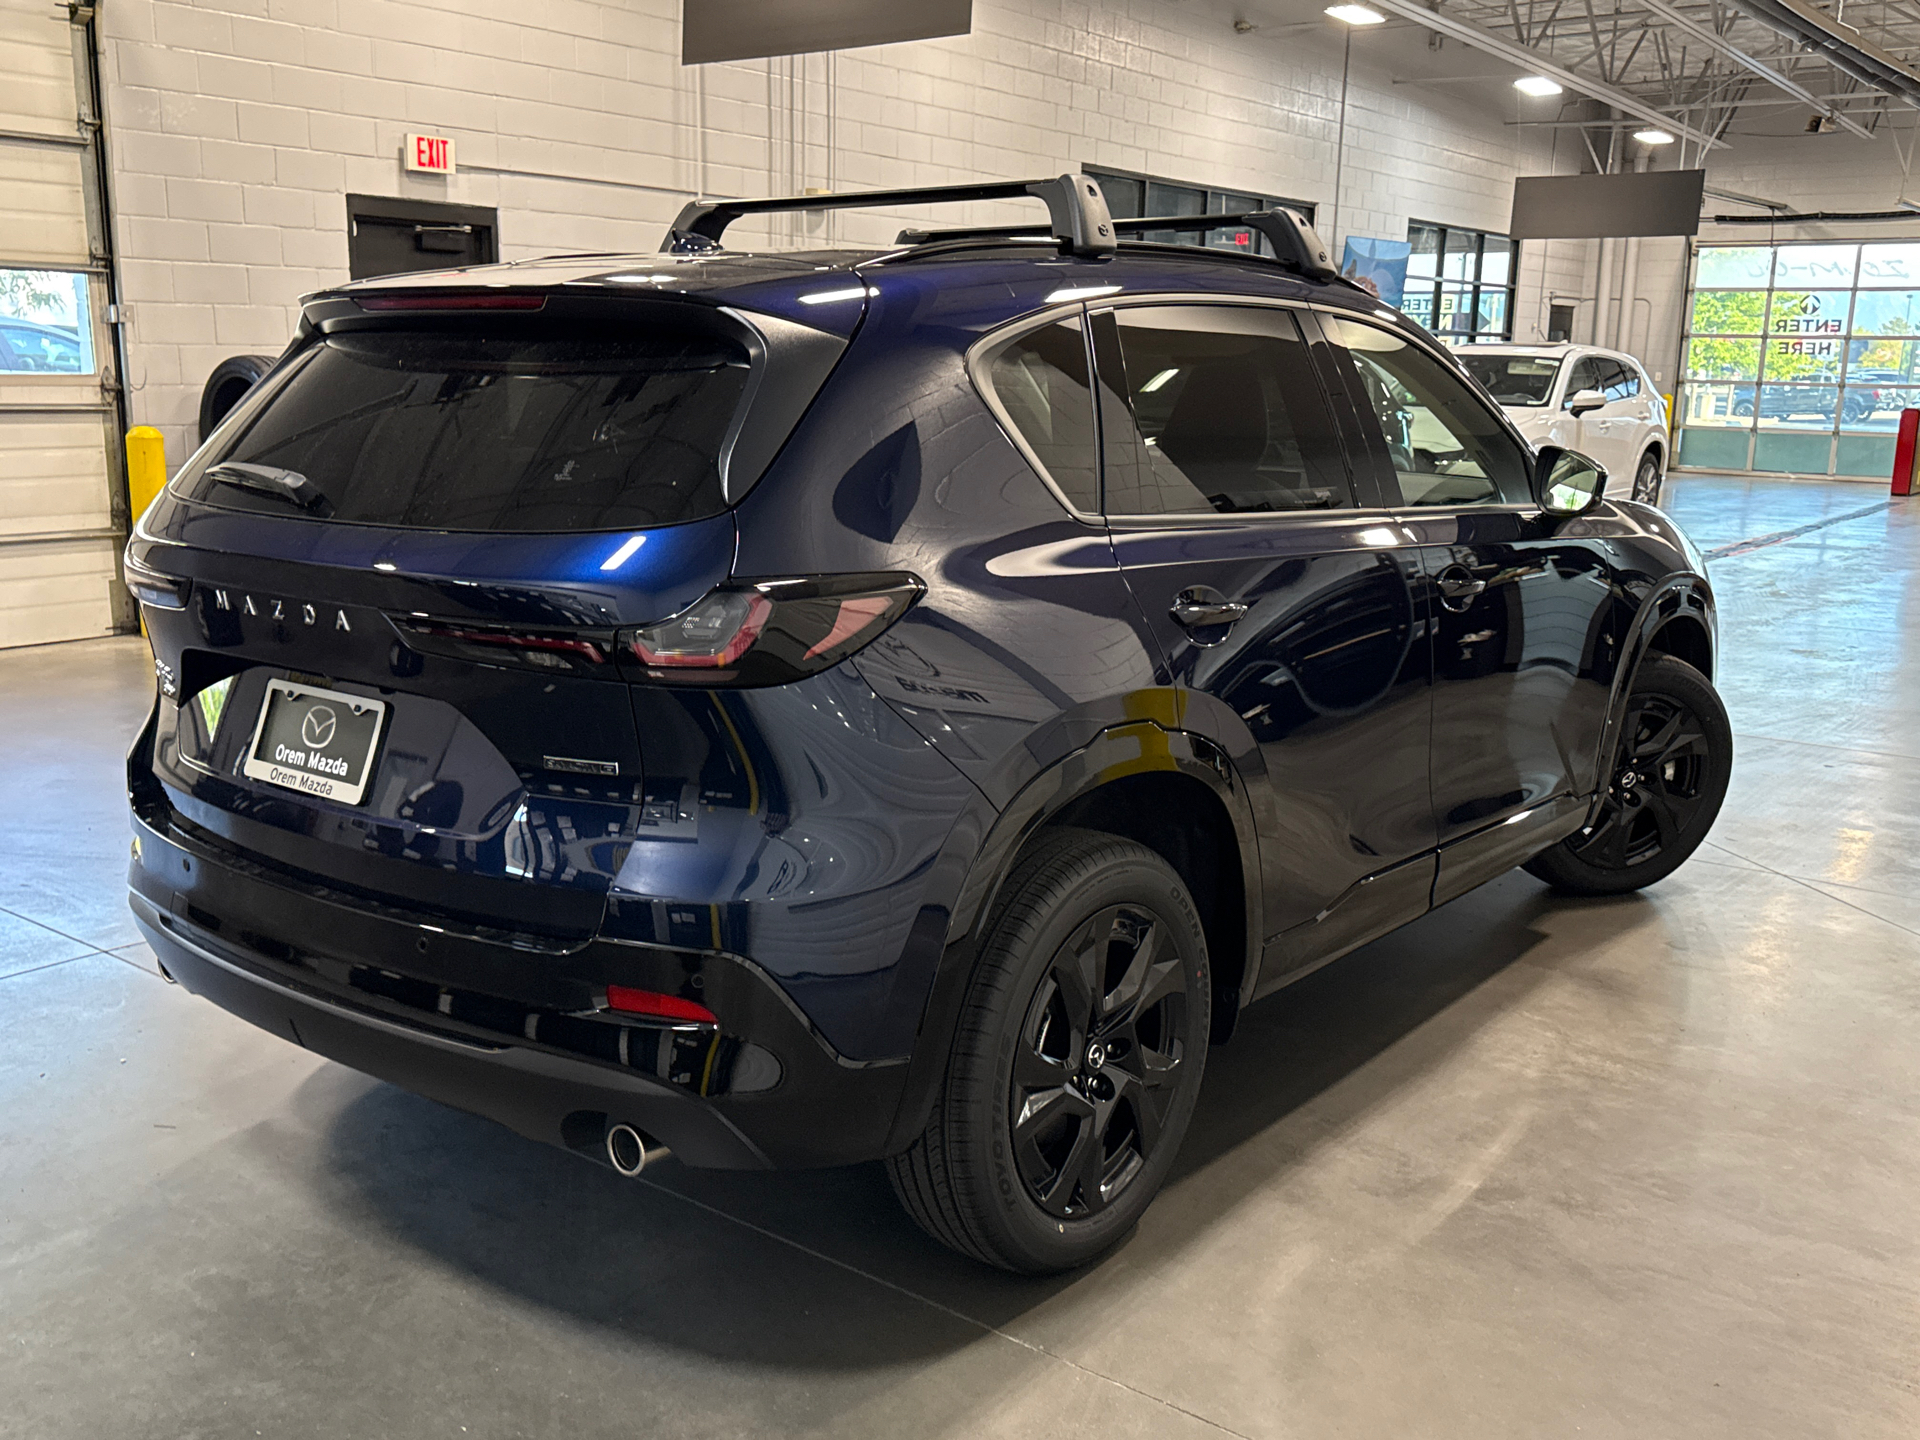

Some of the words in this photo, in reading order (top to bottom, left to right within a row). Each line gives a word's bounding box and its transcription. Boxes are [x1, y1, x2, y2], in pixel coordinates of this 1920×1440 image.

[417, 136, 449, 170] EXIT
[215, 589, 351, 632] MAZDA
[275, 743, 306, 766] Orem
[307, 750, 349, 777] Mazda
[270, 767, 297, 786] Orem
[298, 774, 333, 796] Mazda
[1170, 887, 1201, 939] OPEN
[992, 1139, 1017, 1212] TOYO
